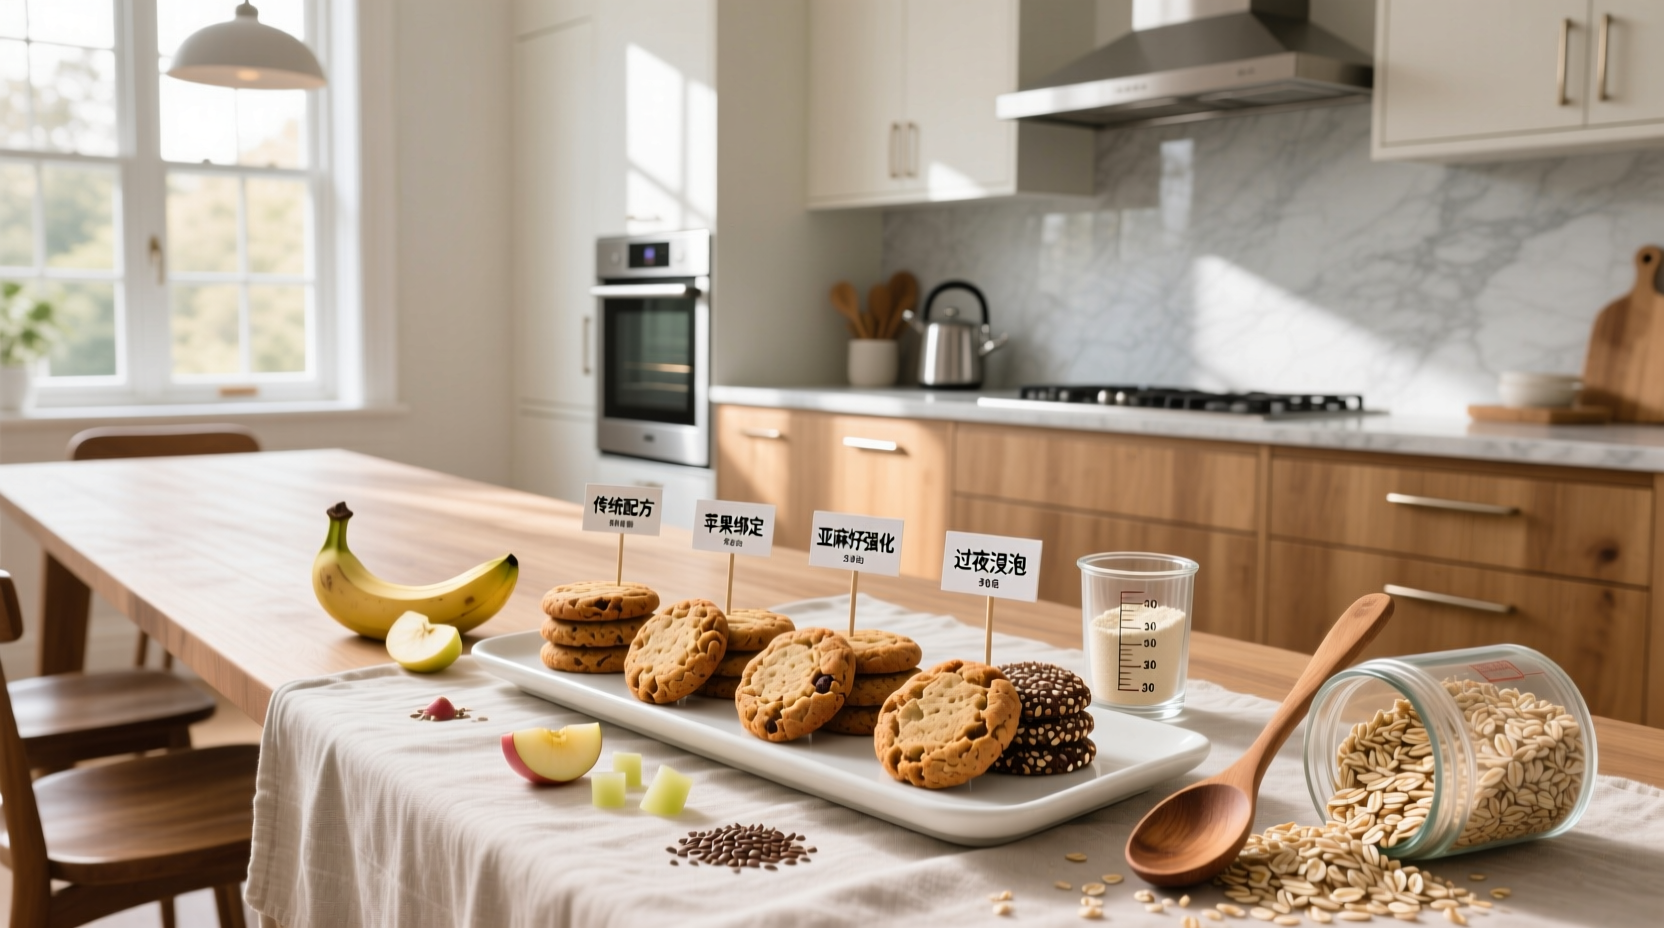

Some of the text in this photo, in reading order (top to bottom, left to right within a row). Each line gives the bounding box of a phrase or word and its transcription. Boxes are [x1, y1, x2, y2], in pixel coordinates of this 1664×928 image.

[593, 495, 655, 517] 传统配方
[703, 513, 764, 536] 苹果绑定
